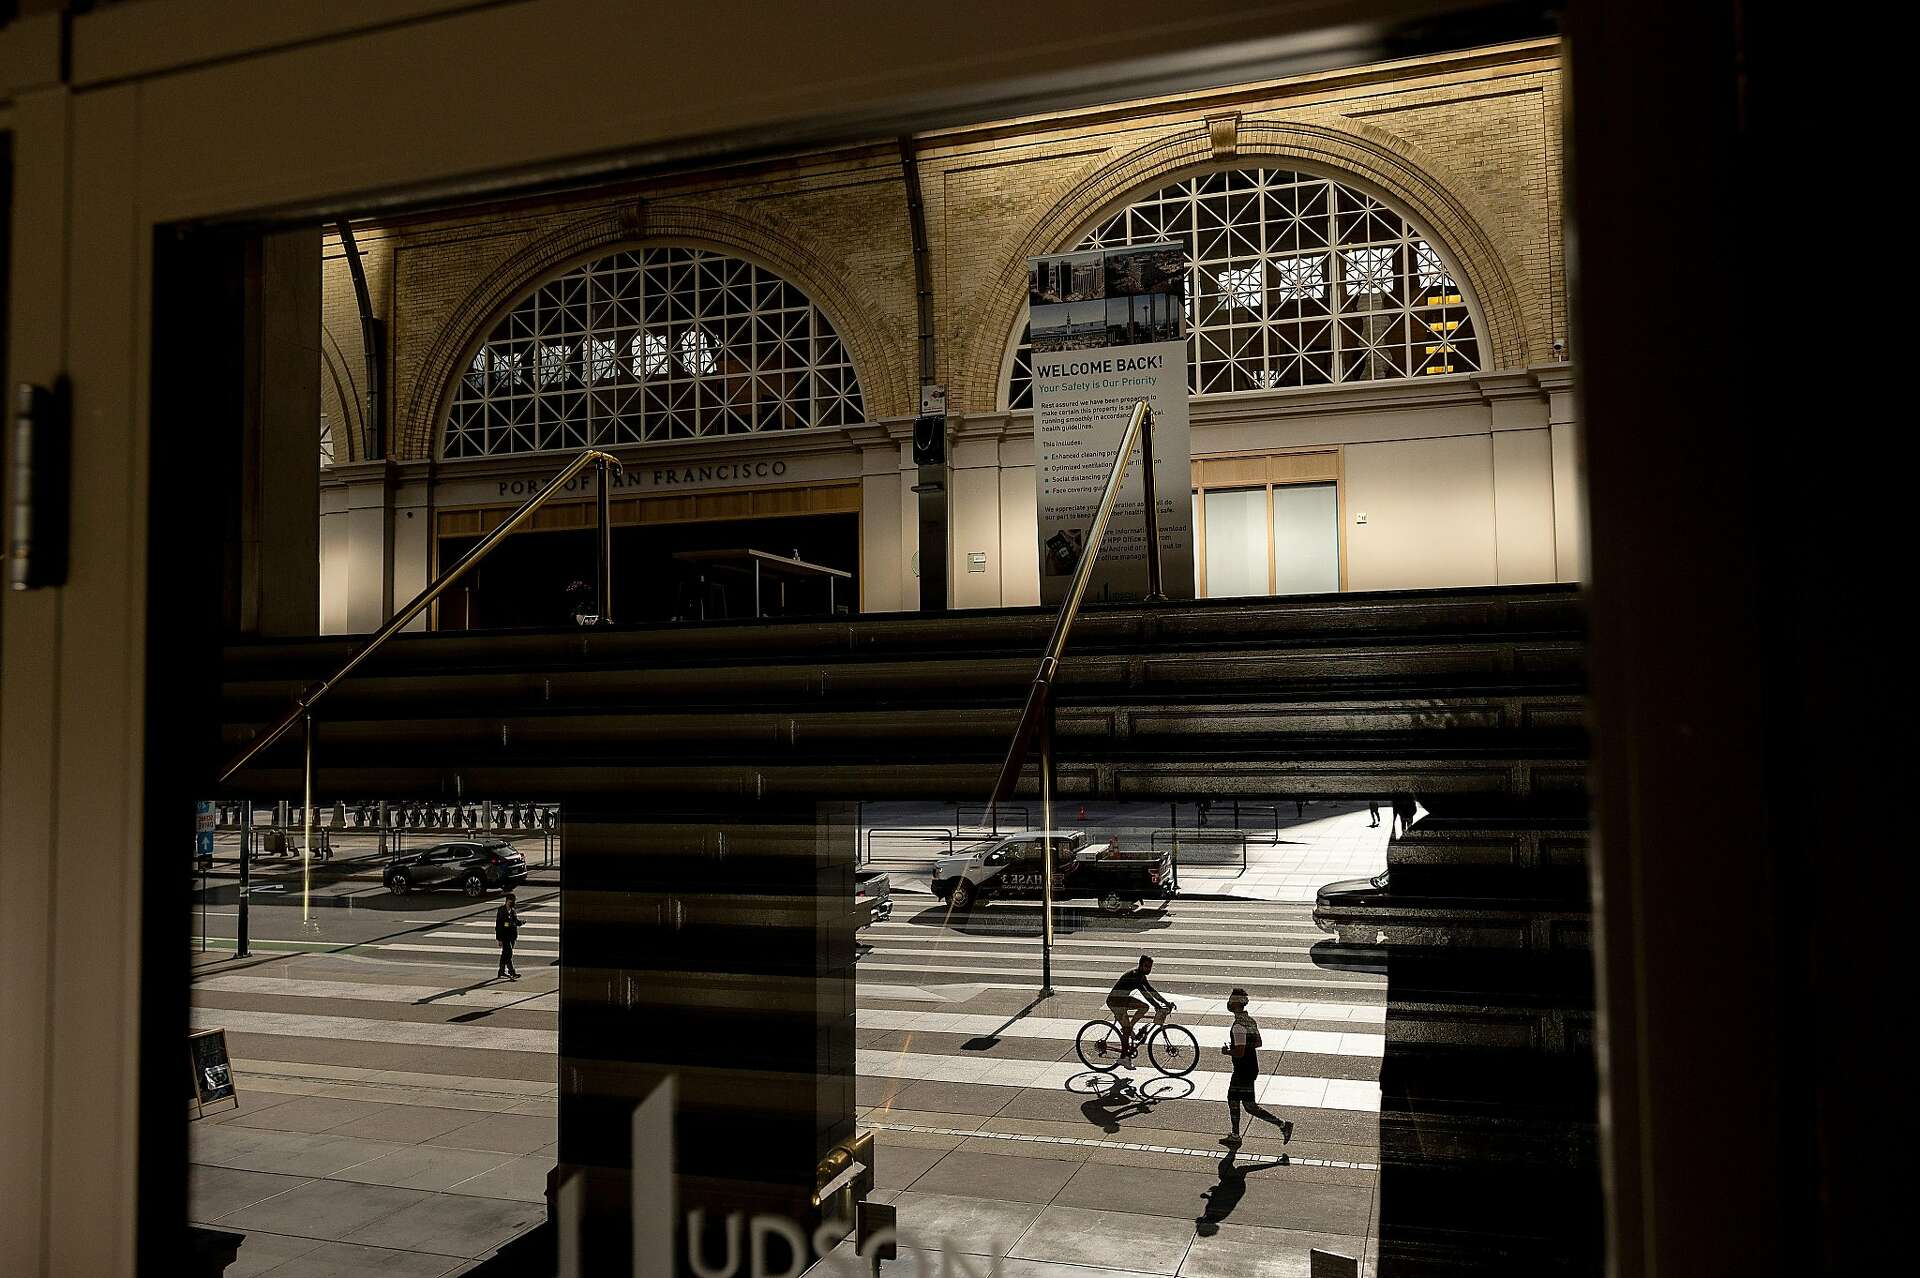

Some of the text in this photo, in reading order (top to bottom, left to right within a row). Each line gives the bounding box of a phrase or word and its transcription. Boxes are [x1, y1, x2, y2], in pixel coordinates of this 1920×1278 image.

[1037, 355, 1162, 378] WELCOME BACK!
[1039, 376, 1157, 393] Your Safety is Our Priority
[1101, 412, 1131, 420] accordanc
[1081, 450, 1106, 458] cleaning
[1052, 463, 1081, 472] Optimized
[499, 461, 787, 497] POR OF AN FRANCISCO
[1071, 474, 1101, 482] distancing
[1115, 527, 1145, 535] informati
[1159, 525, 1187, 533] ownload
